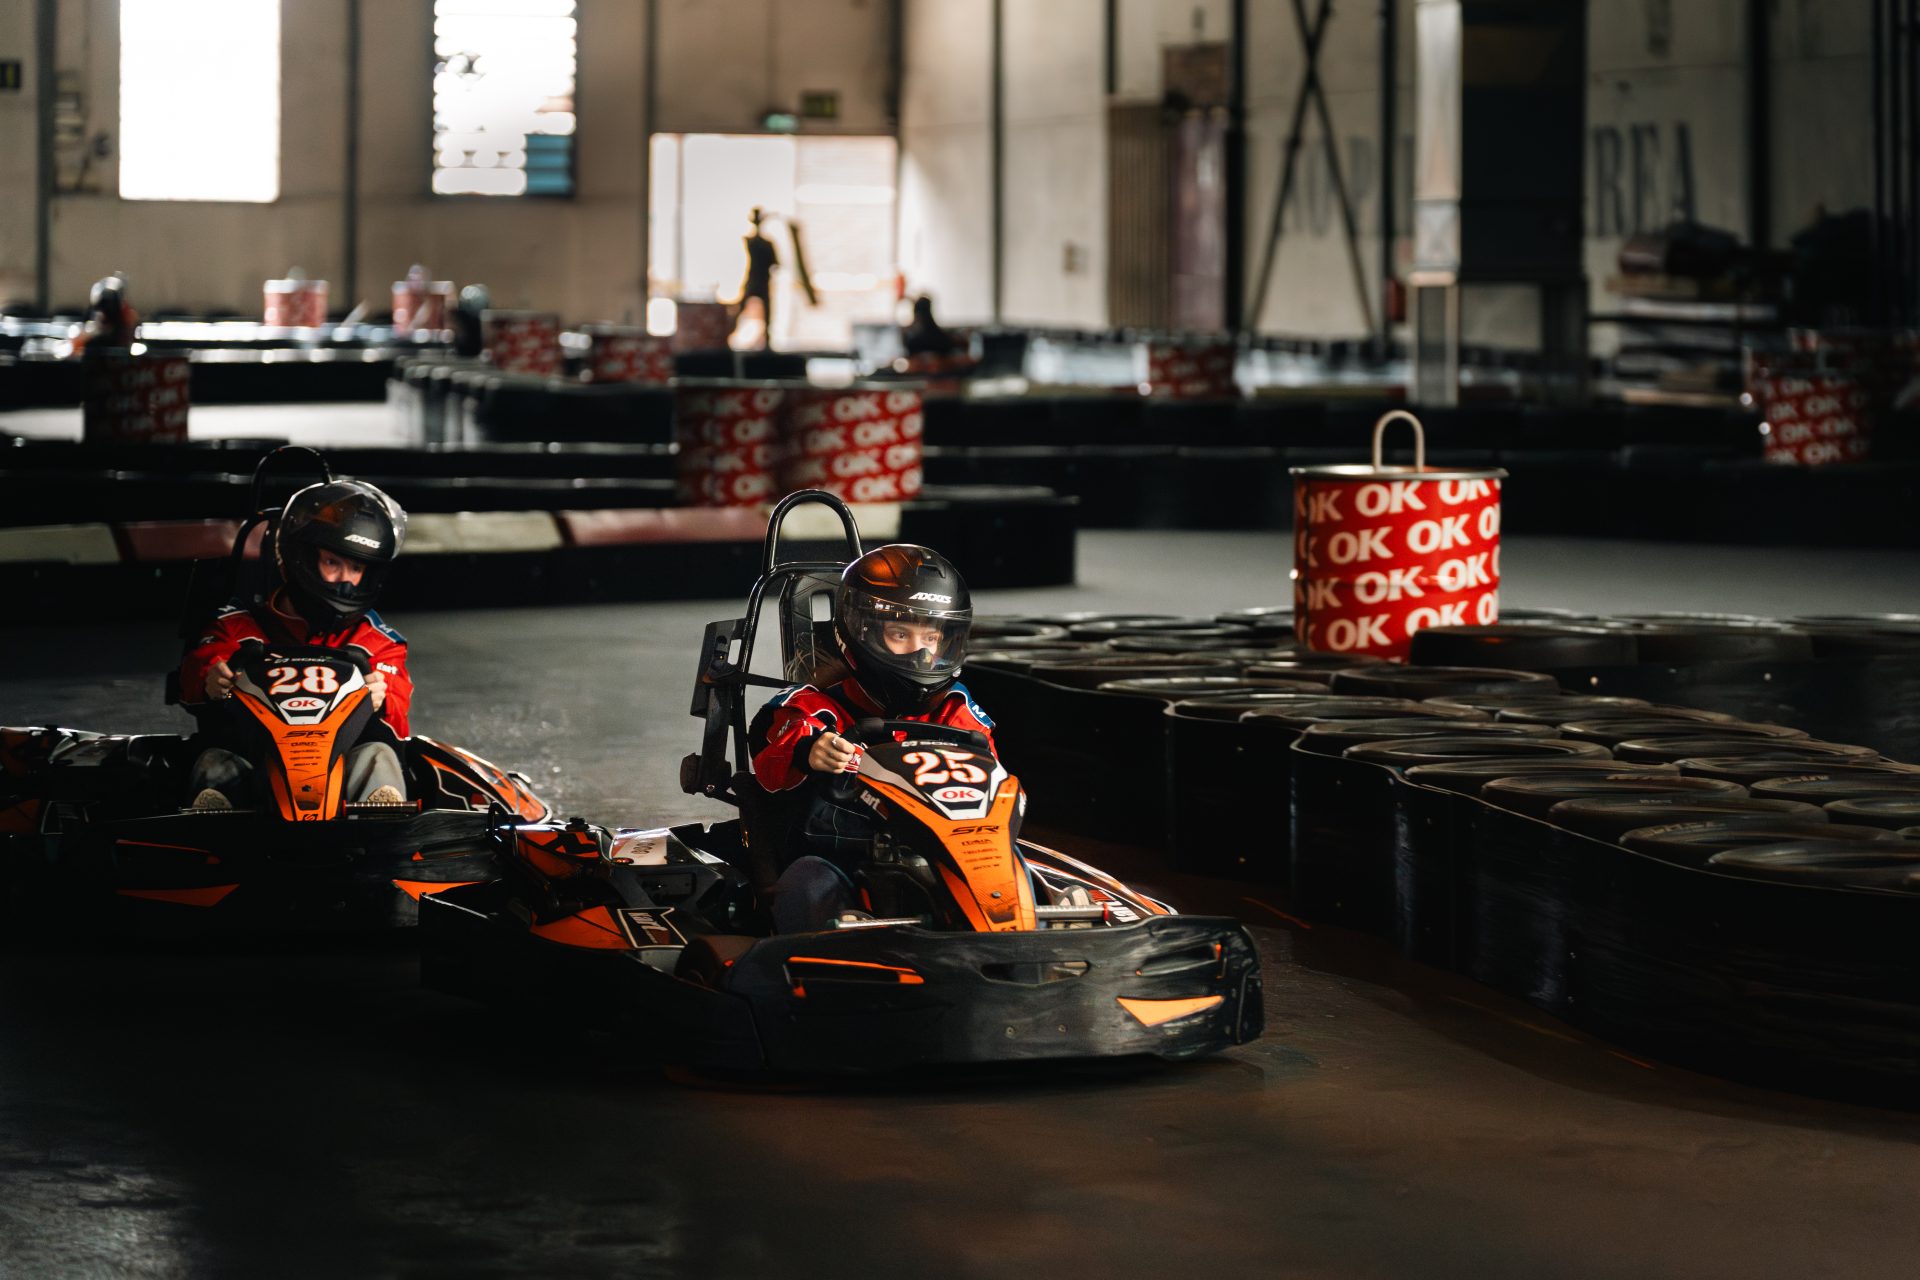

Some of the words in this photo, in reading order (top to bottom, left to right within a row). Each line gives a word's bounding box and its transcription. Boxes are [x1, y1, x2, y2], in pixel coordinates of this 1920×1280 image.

[833, 393, 883, 423] OK
[852, 416, 900, 448] OK
[832, 449, 883, 479] OK
[852, 472, 900, 502] OK
[1354, 479, 1427, 518] OK
[1437, 478, 1491, 506] OK
[1327, 525, 1394, 566] OK
[1405, 513, 1472, 555] OK
[1353, 565, 1426, 605] OK
[1436, 551, 1491, 593] OK
[1325, 613, 1393, 651] OK
[1404, 600, 1469, 638] OK
[266, 665, 340, 696] 28
[287, 699, 316, 708] OK
[901, 748, 989, 787] 25
[941, 790, 977, 799] OK
